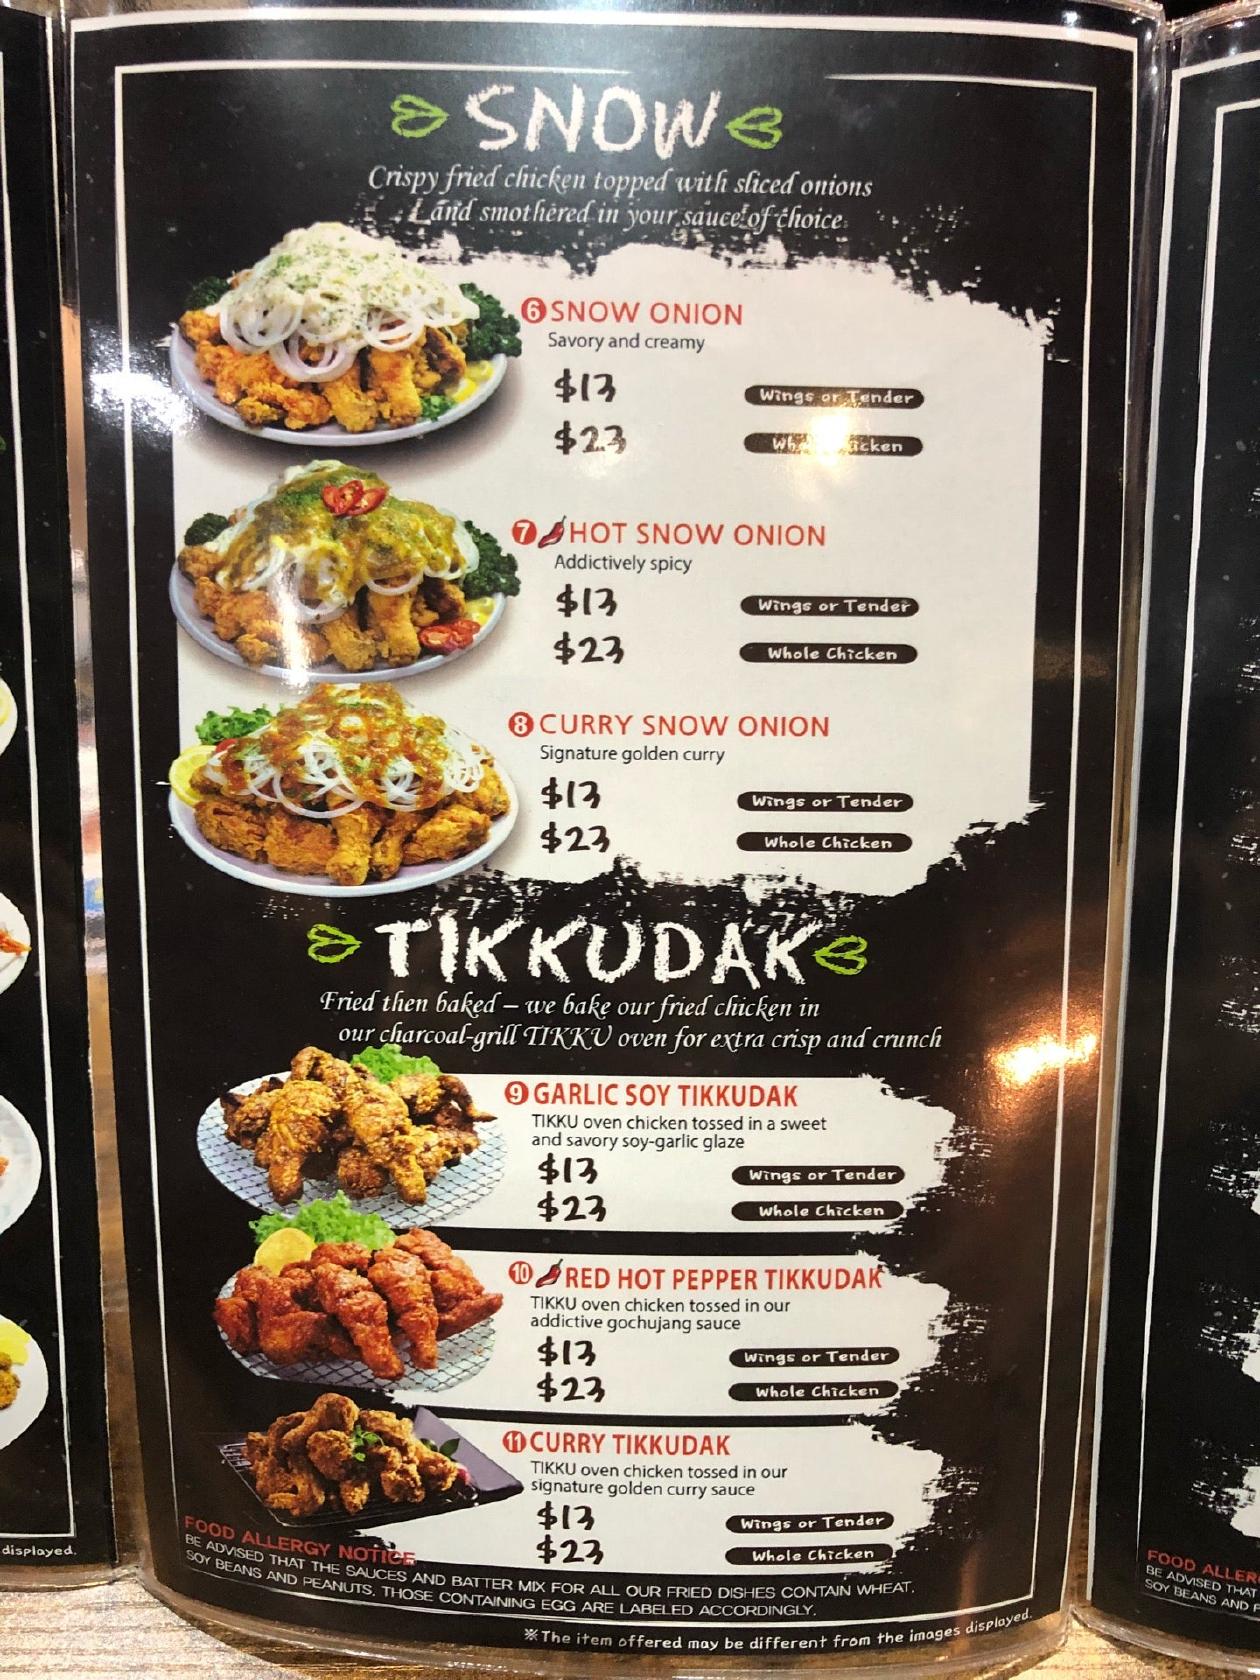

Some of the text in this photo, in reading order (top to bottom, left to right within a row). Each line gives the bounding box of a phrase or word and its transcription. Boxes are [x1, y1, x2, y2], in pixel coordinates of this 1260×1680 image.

[464, 83, 722, 160] SNOW
[368, 163, 873, 198] Crispy fried chicken topped with sliced onions
[430, 198, 842, 232] and smothered in your sauce choice
[551, 301, 743, 325] SNOW ONION
[548, 332, 705, 354] Savory and creamy
[554, 368, 616, 404] $13
[554, 420, 627, 455] $23
[570, 522, 825, 546] HOT SNOW ONION
[554, 554, 692, 574] Addictively spicy
[556, 584, 618, 617] $13
[758, 598, 911, 614] Wings or Tender
[554, 632, 625, 665] $23
[768, 647, 897, 661] Whole Chicken
[540, 714, 829, 737] CURRY SNOW ONION
[541, 745, 725, 764] Signature golden curry
[541, 777, 600, 809] $13
[541, 822, 610, 853] $23
[374, 916, 819, 989] TIKKUDAK
[320, 990, 820, 1022] Fried then baked we bake our fried chicken in
[338, 1022, 942, 1055] our charcoal-grill TIKKU oven for extra crisp and crunch
[534, 1083, 798, 1107] GARLIC SOY TIKKUDAK
[532, 1114, 827, 1130] TIKKU oven chicken tossed in sweet
[532, 1133, 745, 1152] and savory soy-garlic glaze
[538, 1152, 598, 1185] $13
[537, 1191, 607, 1222] $23
[565, 1268, 883, 1290] RED HOT PEPPER TIKKUDAK
[530, 1296, 791, 1313] TIKKU oven chicken tossed in our
[530, 1314, 741, 1332] addictive gochujang sauce
[537, 1335, 596, 1367] $13
[537, 1372, 605, 1403] $23
[530, 1431, 731, 1456] CURRY TIKKUDAK
[531, 1461, 788, 1478] TIKKU oven chicken tossed in our
[531, 1479, 755, 1499] signature golden curry sauce
[537, 1501, 595, 1530] $13
[2, 1545, 77, 1558] displayed.
[184, 1516, 417, 1567] FOOD ALLERGY NOTICE
[536, 1535, 604, 1565] $23
[185, 1533, 915, 1599] BE ADVISED THAT THE SAUCES AND BATTER MIX FOR ALL OUR FRIED DISHES CONTAIN WHEAT.
[1146, 1565, 1256, 1598] BE ADVISED THAT
[185, 1549, 817, 1616] SOY BEANS AND PEANUTS. THOSE CONTAINING EGG ARE LABELED ACCORDINGLY.
[1145, 1578, 1170, 1593] SOY
[1174, 1587, 1217, 1605] BEANS
[1221, 1599, 1249, 1611] AND
[541, 1608, 1033, 1651] The item offered may be different from the images displayed.
